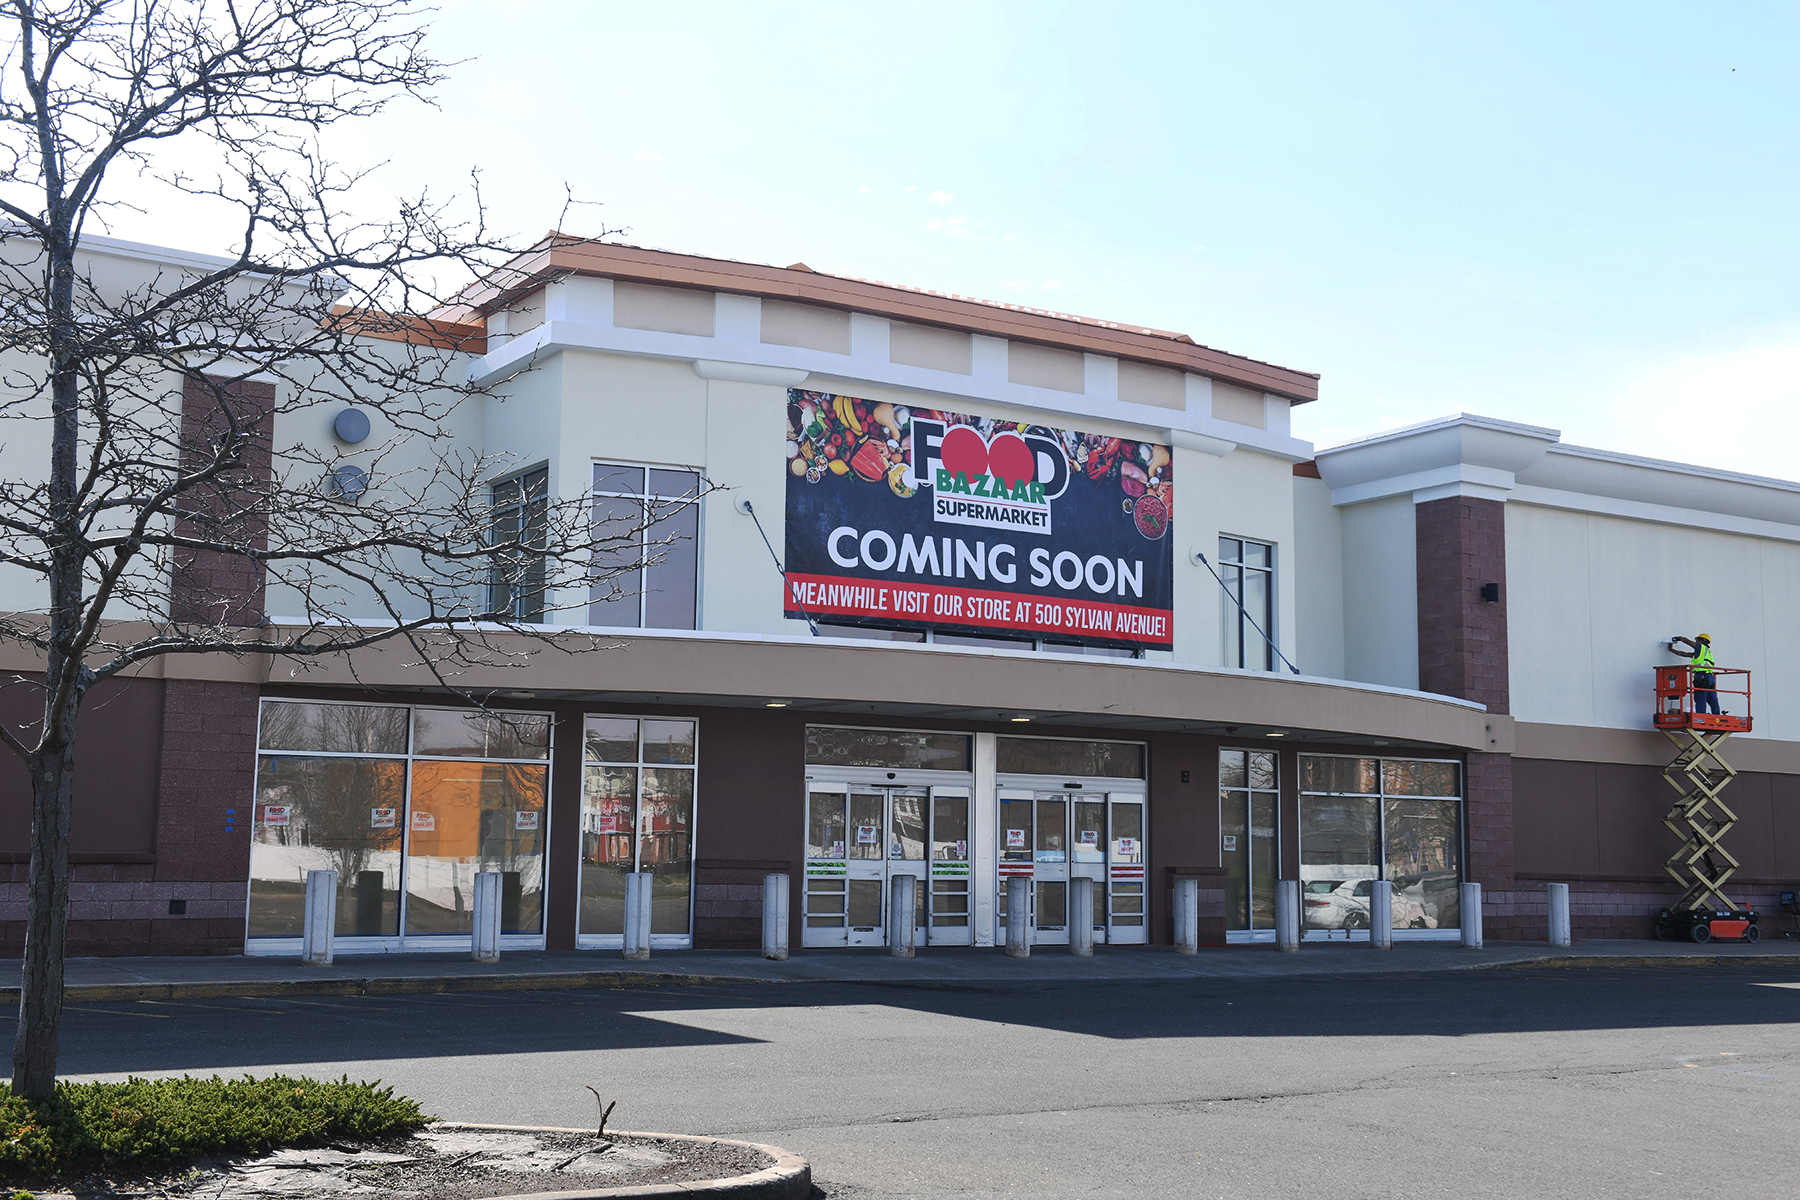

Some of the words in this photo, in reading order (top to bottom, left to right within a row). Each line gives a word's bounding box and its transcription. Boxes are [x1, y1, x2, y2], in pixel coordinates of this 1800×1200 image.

[913, 420, 1067, 497] FOOD
[936, 468, 1047, 505] BAZAAR
[936, 499, 1048, 528] SUPERMARKET
[827, 526, 1017, 584] COMING
[1029, 547, 1144, 598] SOON
[792, 581, 888, 611] MEANWHILE
[893, 589, 930, 615] VISIT
[933, 593, 963, 617] OUR
[966, 597, 1011, 622] STORE
[1015, 601, 1032, 623] AT
[1035, 603, 1062, 626] 500
[1065, 606, 1112, 632] SYLVAN
[1115, 612, 1166, 637] AVENUE!
